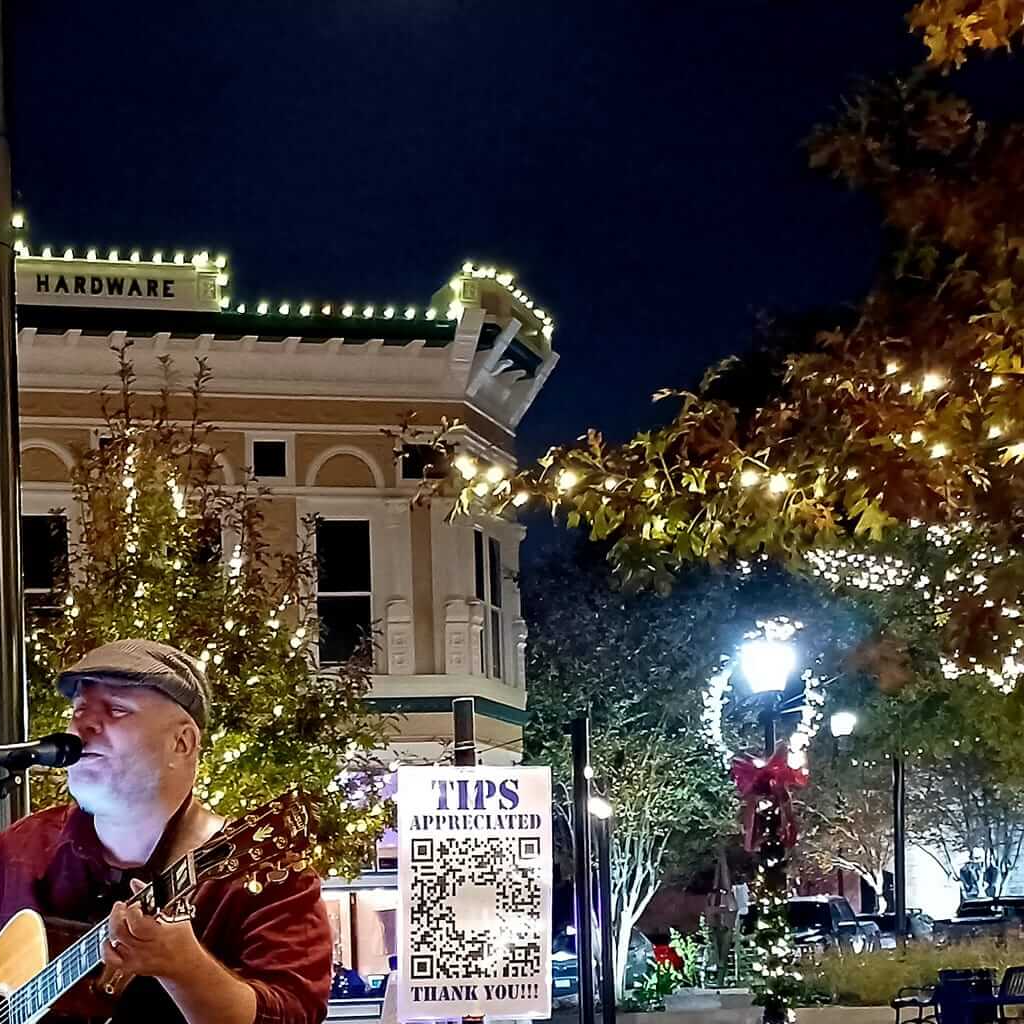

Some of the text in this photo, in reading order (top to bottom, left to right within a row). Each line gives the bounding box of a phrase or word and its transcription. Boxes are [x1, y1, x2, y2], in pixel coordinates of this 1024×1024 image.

[36, 274, 175, 297] HARDWARE
[431, 778, 520, 810] TIPS
[410, 814, 542, 831] APPRECIATED
[410, 983, 539, 1001] THANK YOU!!!
